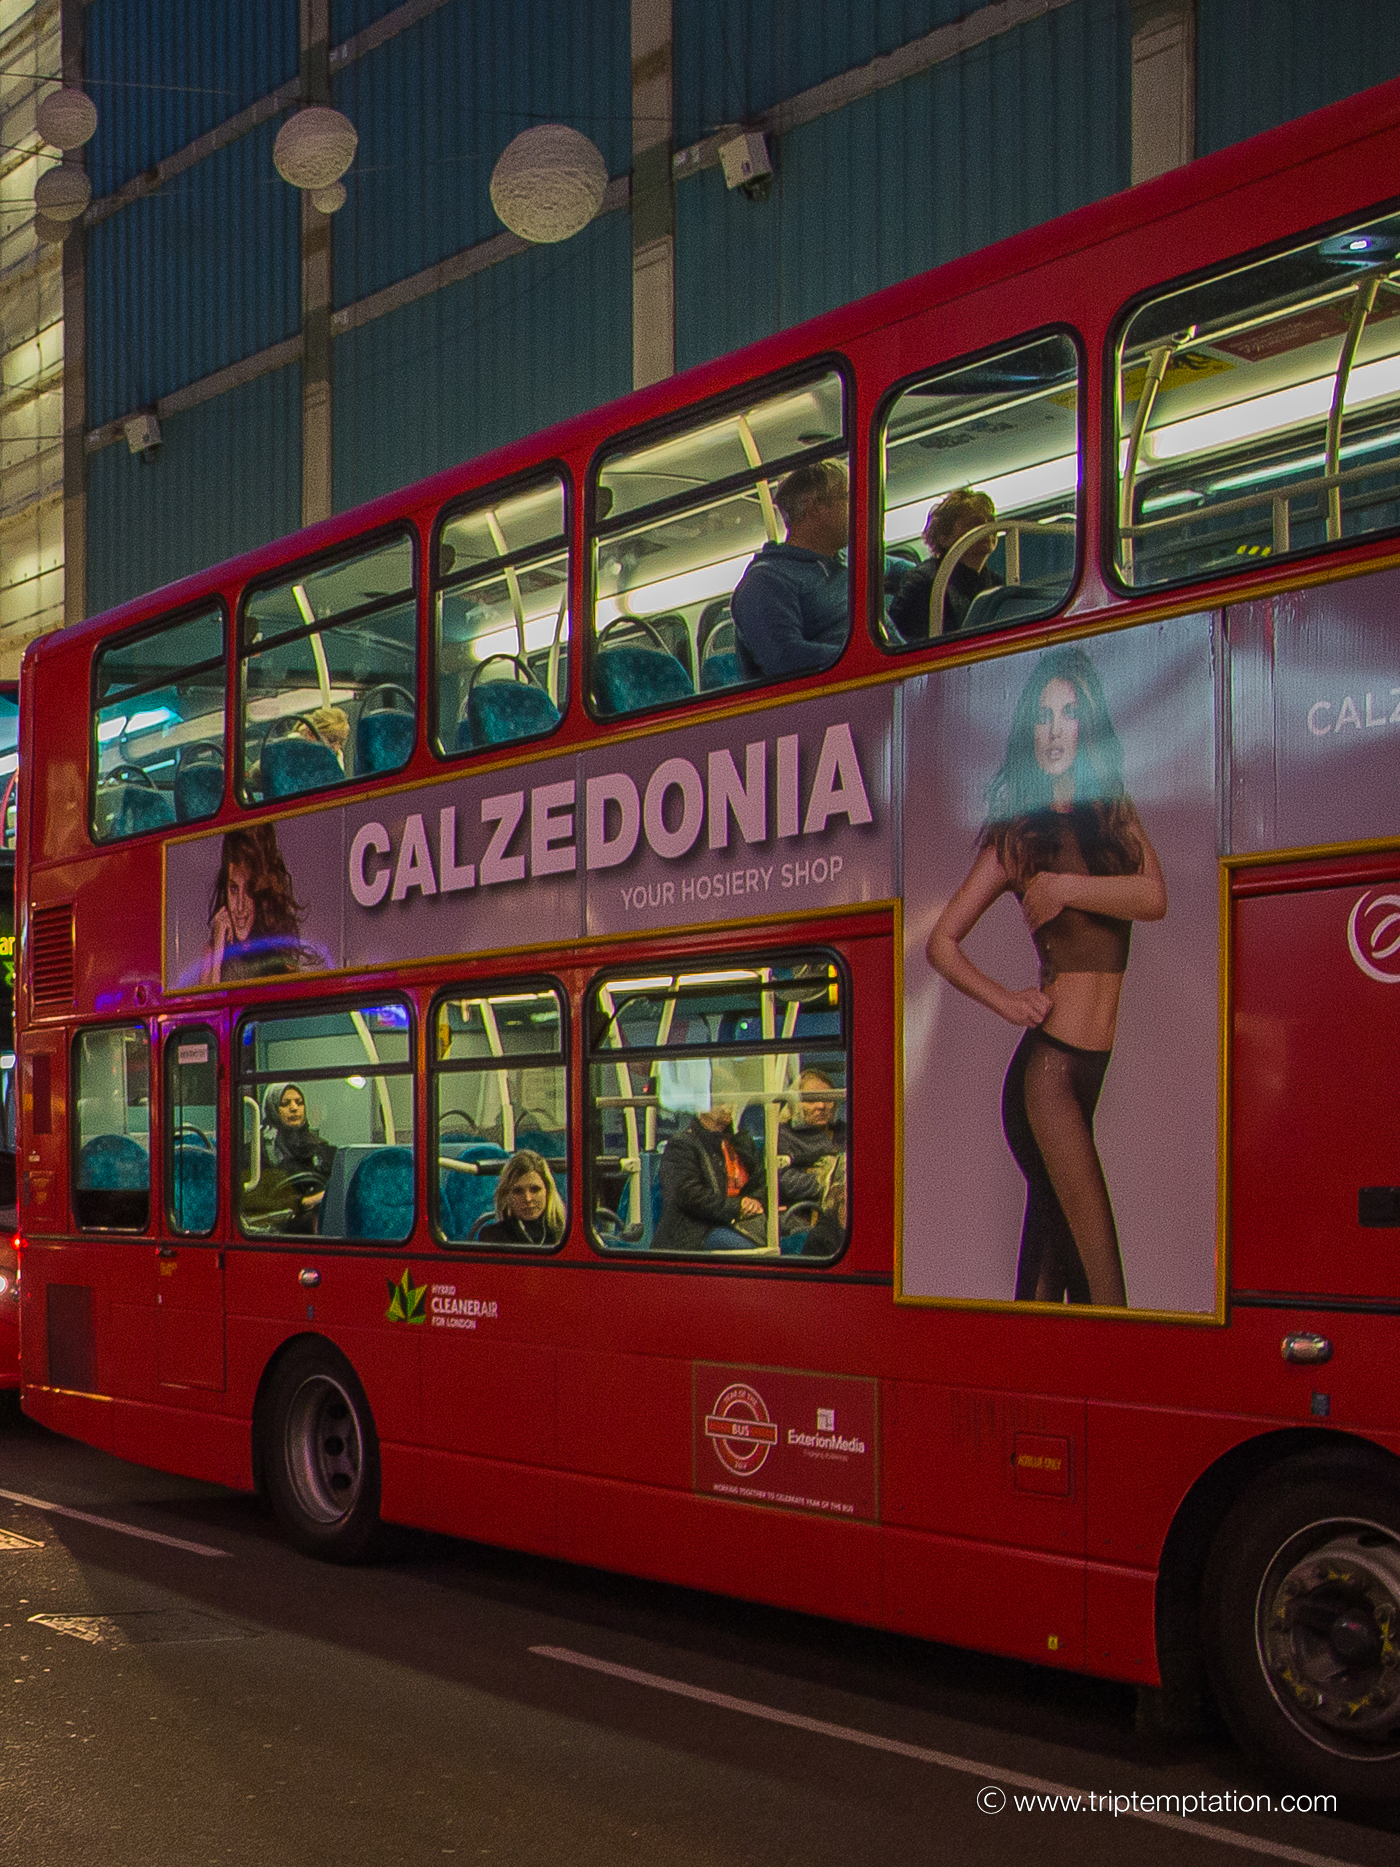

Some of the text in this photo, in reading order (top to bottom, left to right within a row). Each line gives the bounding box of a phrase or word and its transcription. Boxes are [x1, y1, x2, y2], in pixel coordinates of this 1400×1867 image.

[348, 721, 874, 908] CALZEDONIA
[621, 855, 845, 911] YOUR HOSIERY SHOP
[731, 1423, 750, 1437] BUS
[787, 1428, 866, 1454] ExterionMedia
